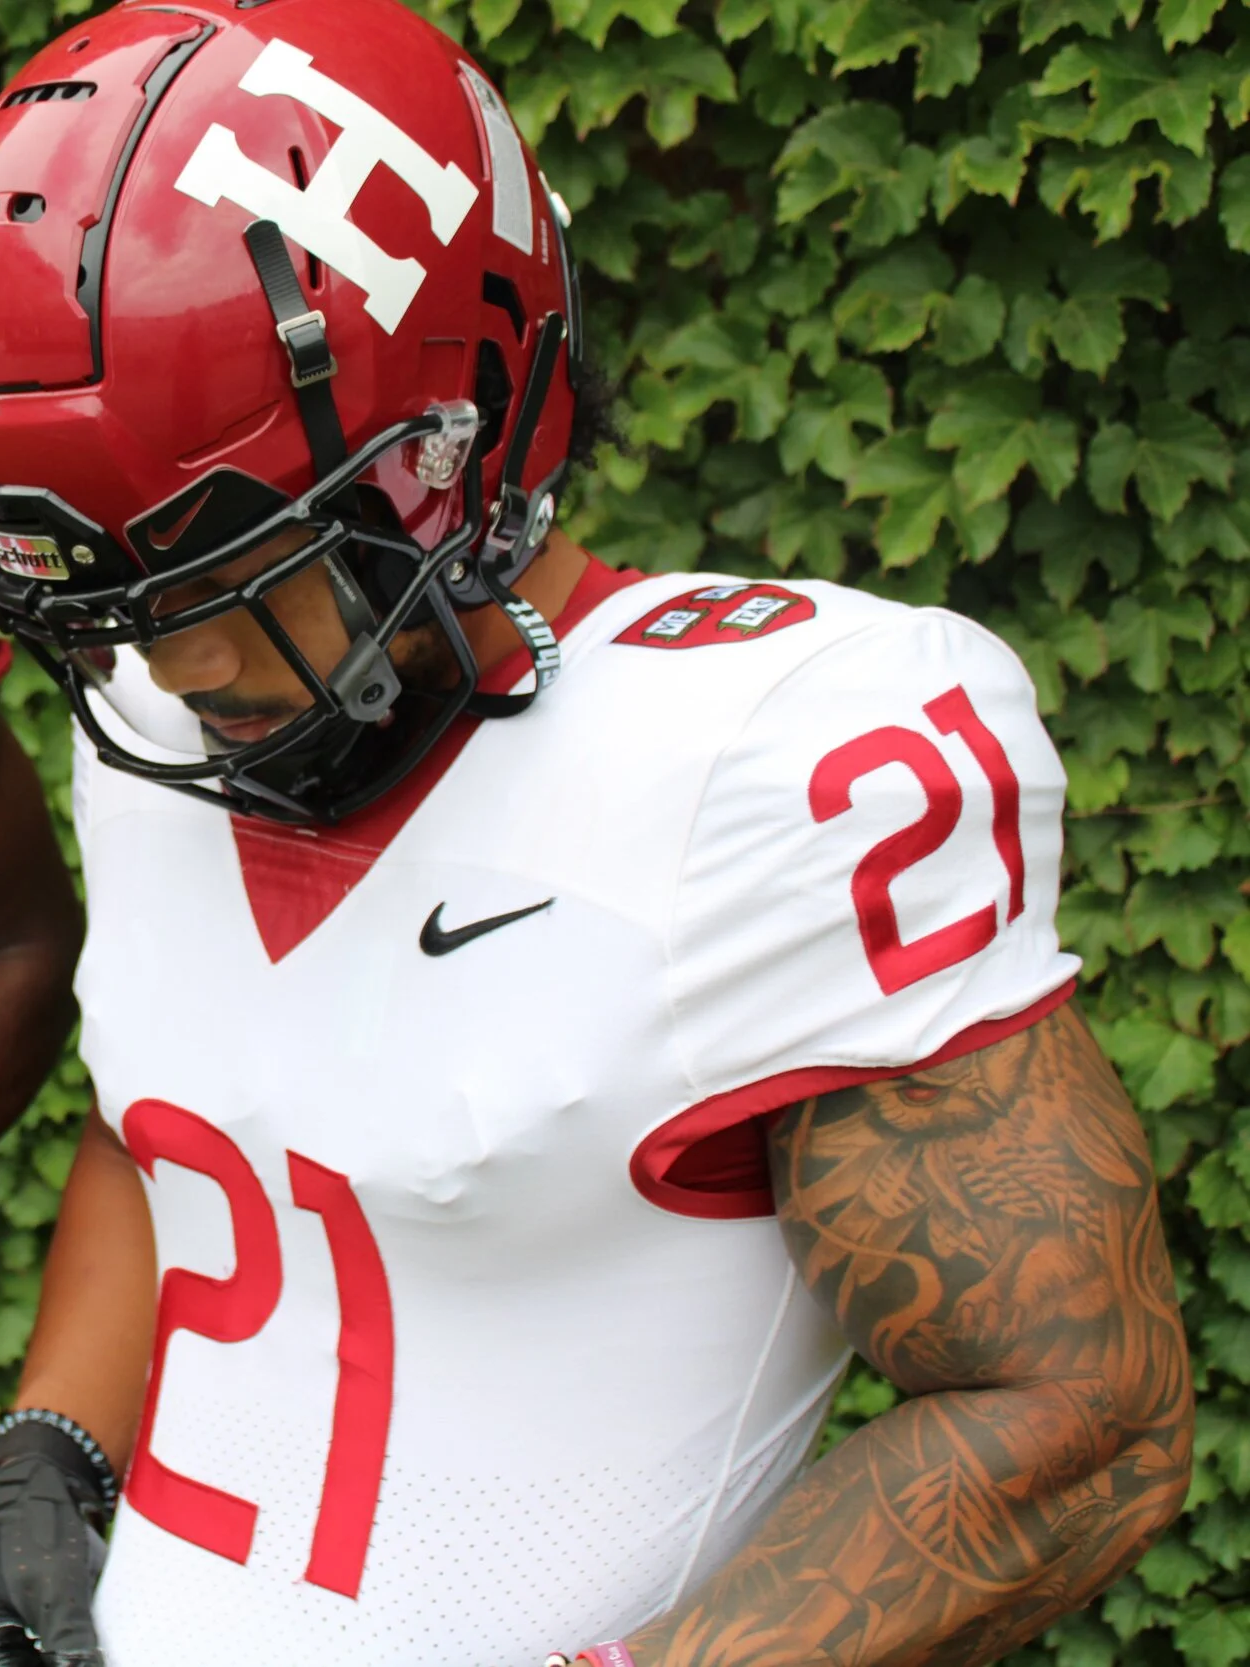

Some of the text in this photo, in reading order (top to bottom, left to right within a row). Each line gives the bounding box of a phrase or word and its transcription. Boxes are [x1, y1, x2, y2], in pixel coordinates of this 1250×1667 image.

[175, 38, 479, 336] H
[655, 612, 692, 633] VE
[734, 598, 779, 623] TAS
[808, 683, 1025, 997] 21
[122, 1098, 394, 1601] 21
